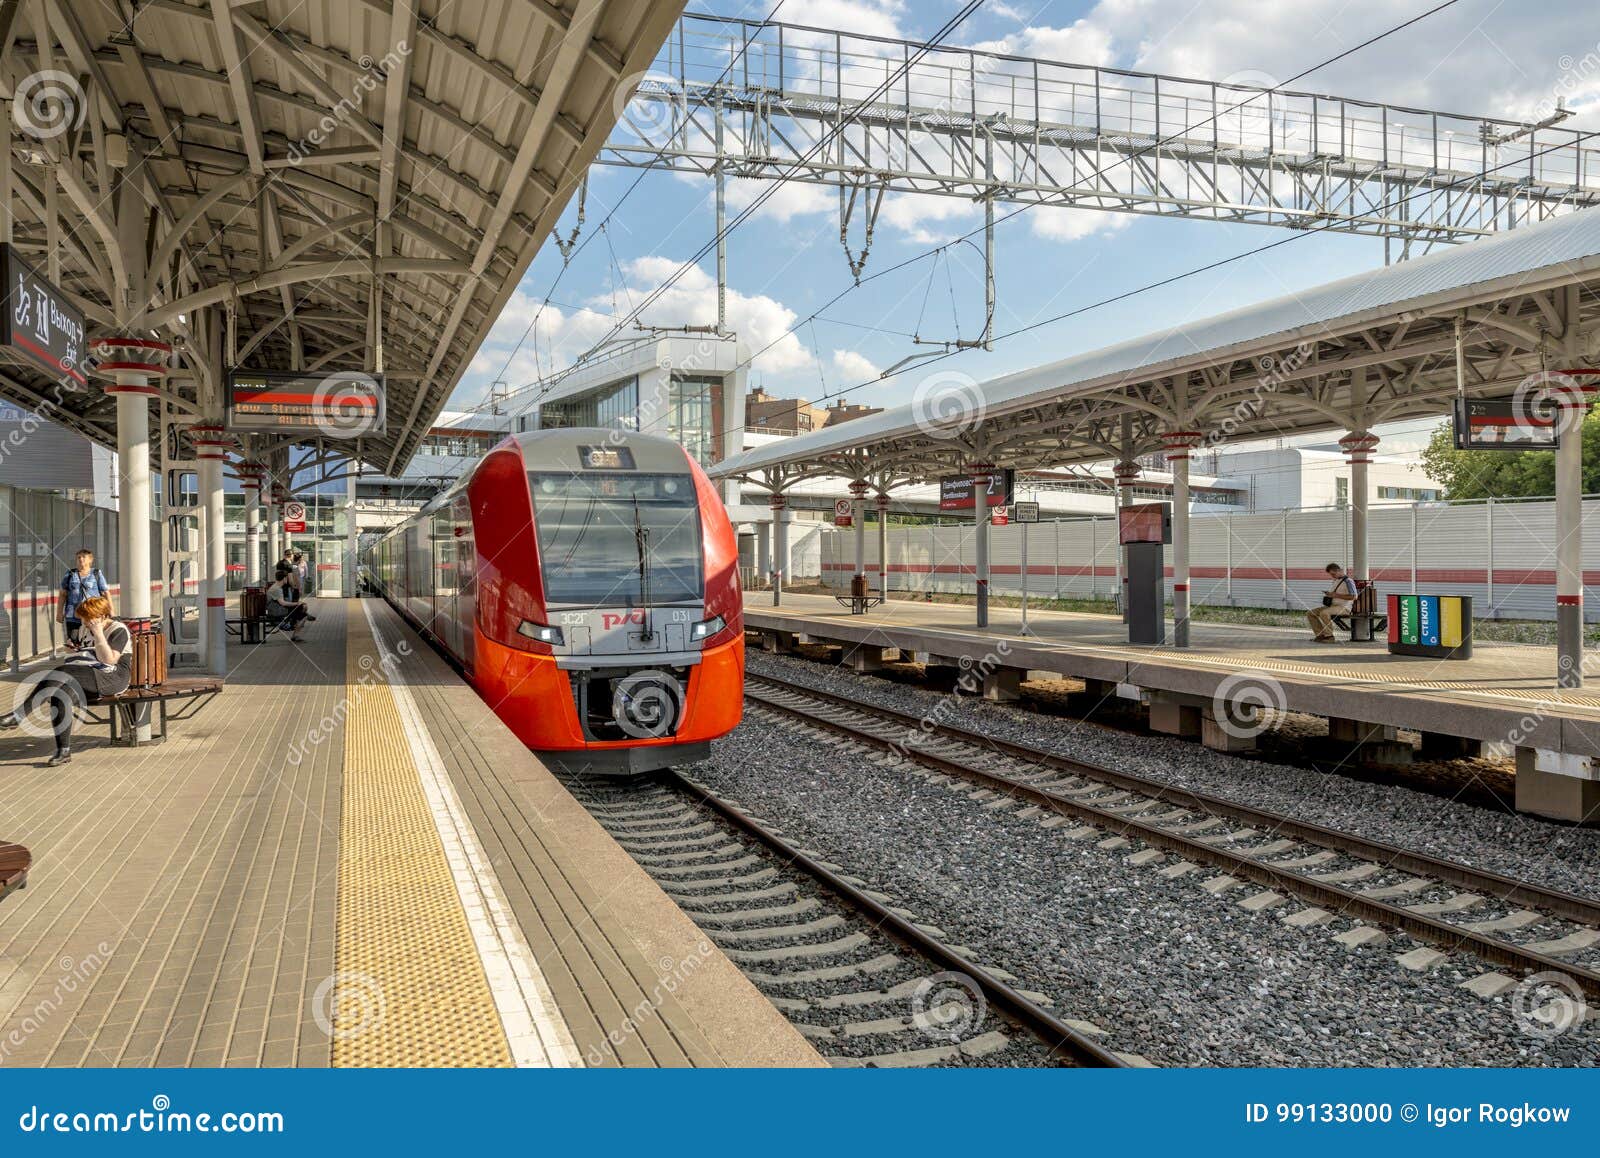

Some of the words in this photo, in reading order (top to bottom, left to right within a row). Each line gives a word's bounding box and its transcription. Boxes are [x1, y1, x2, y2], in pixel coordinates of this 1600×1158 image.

[50, 299, 77, 345] Выход
[986, 476, 994, 495] 2
[672, 611, 690, 622] 031
[1421, 599, 1429, 636] СТЕКЛО
